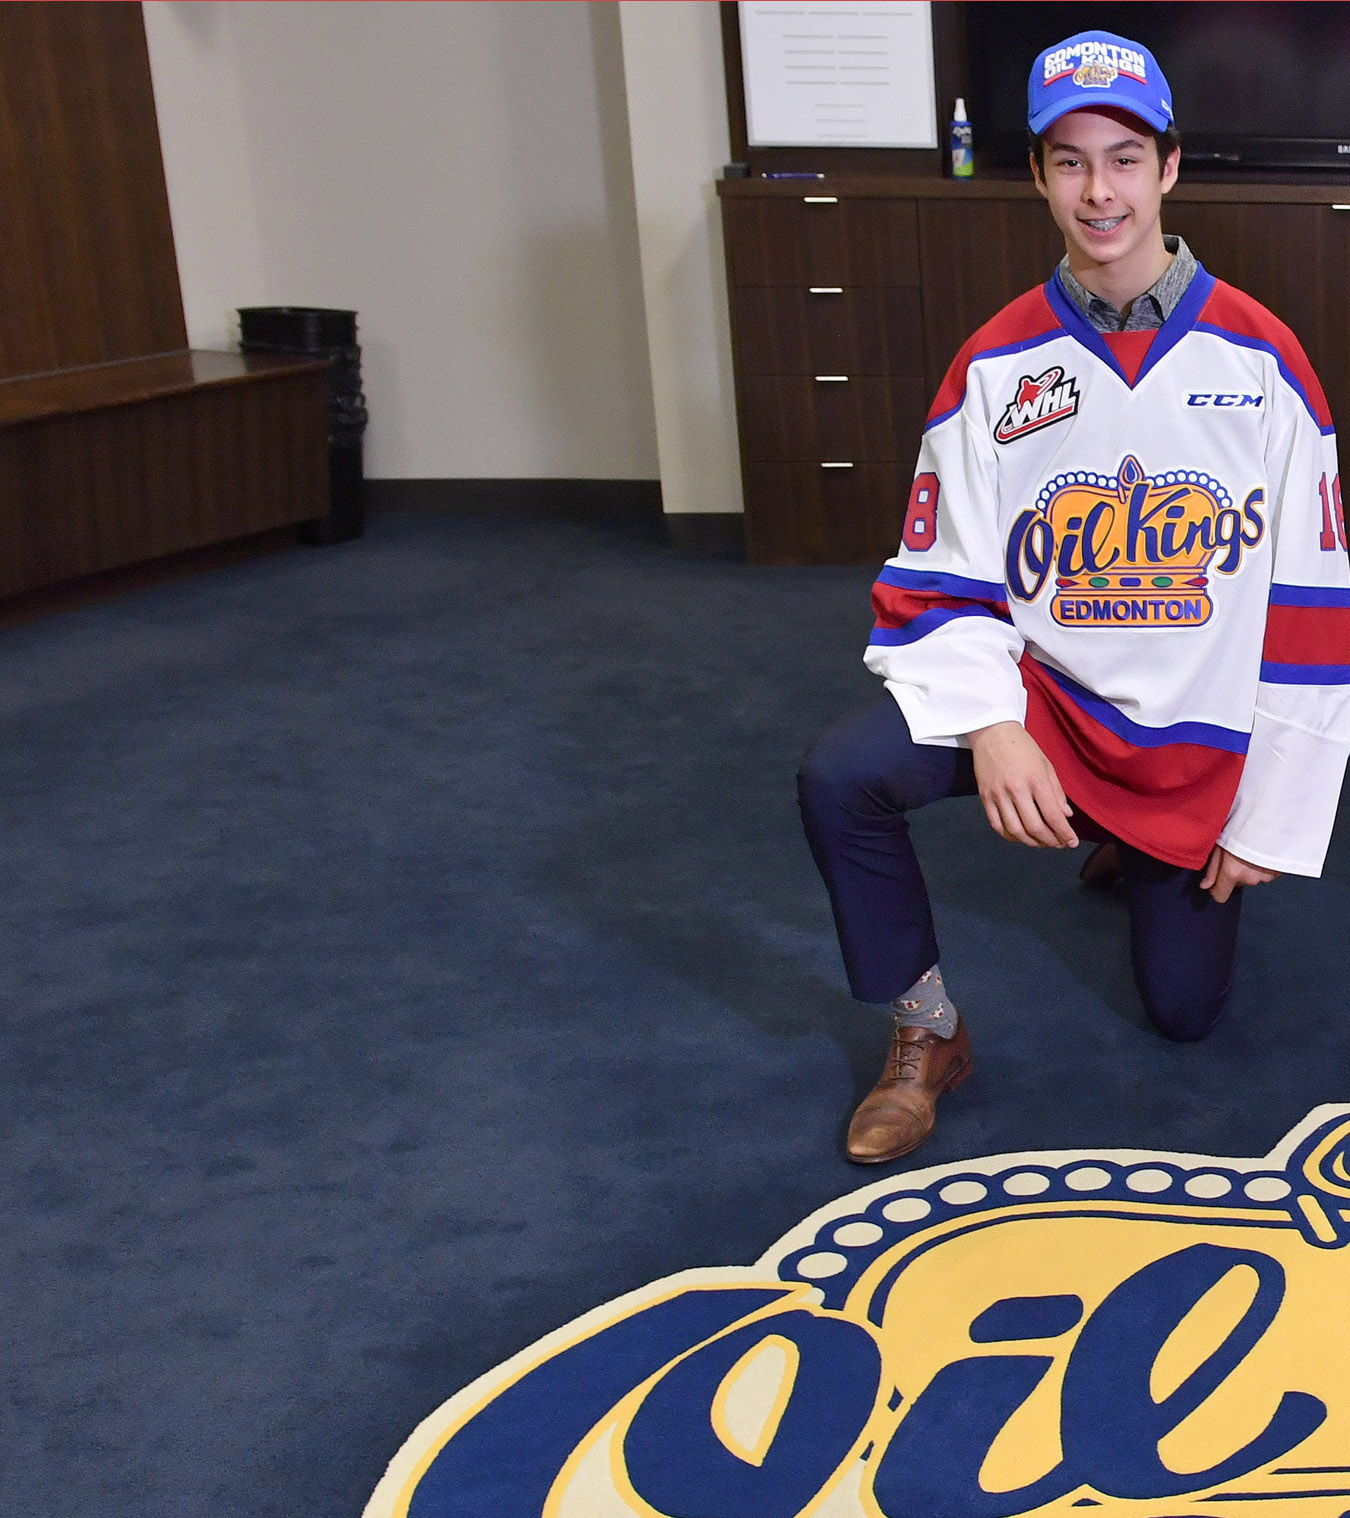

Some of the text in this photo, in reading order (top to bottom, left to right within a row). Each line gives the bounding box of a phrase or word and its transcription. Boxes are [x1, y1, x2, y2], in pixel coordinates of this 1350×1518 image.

[1044, 41, 1146, 70] EDMONTON
[1044, 60, 1075, 79] OIL
[1081, 54, 1146, 78] KINGS
[1008, 381, 1077, 428] WHL
[1187, 393, 1264, 408] CCM
[1005, 482, 1266, 603] Oil Kings
[1060, 599, 1202, 621] EDMONTON
[398, 1240, 1330, 1518] Oil
